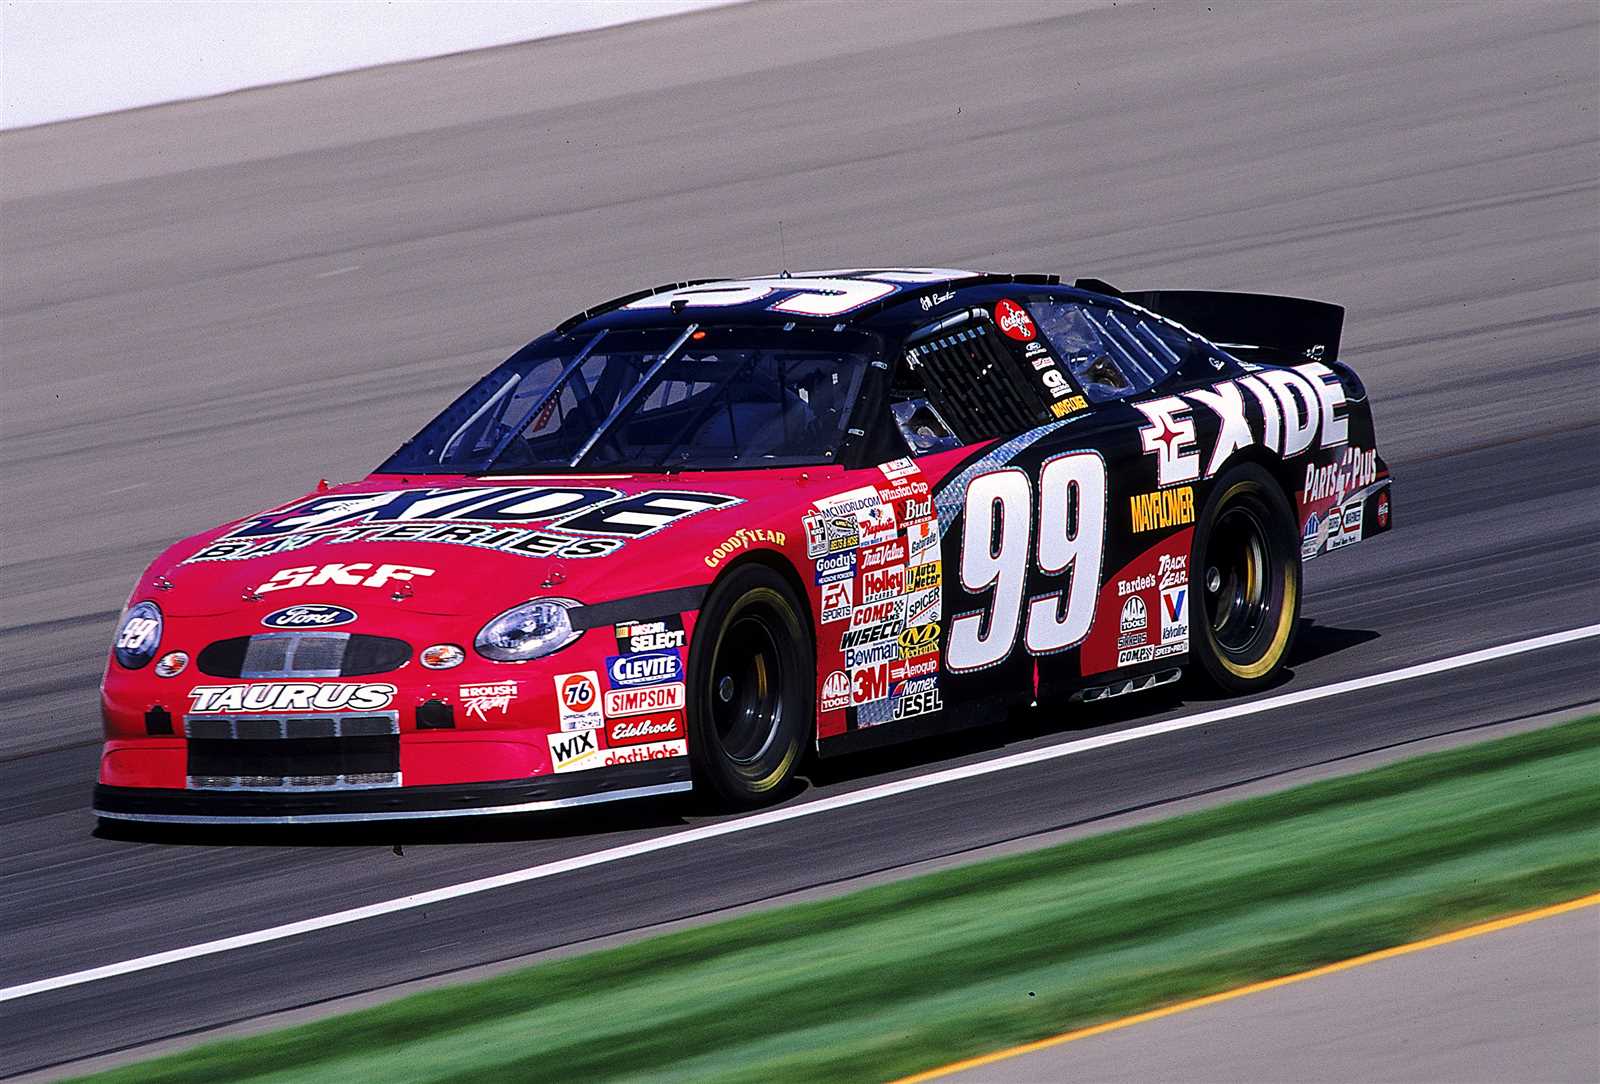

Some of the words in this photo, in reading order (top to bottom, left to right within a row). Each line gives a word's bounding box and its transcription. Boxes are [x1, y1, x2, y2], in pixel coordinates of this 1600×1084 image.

[1132, 362, 1350, 488] EXIDE
[879, 486, 913, 502] Winston
[911, 482, 929, 494] Cup
[210, 486, 747, 543] EXIDE
[905, 495, 932, 521] Bud
[1130, 486, 1195, 533] MAYFLOWER
[177, 523, 626, 567] BATTERIES
[704, 528, 786, 568] GOODYEAR
[880, 543, 905, 565] Value
[911, 532, 938, 554] Gatorade
[816, 552, 857, 573] Goody's
[916, 564, 936, 578] Auto
[946, 449, 1107, 674] 99
[1158, 554, 1187, 576] TRACK
[254, 563, 436, 594] SKF
[865, 568, 904, 596] Holley
[915, 573, 940, 590] Meter
[1118, 574, 1156, 596] Hardee's
[822, 606, 851, 621] SPORTS
[853, 602, 894, 626] COMP
[909, 587, 940, 618] SPICER
[276, 605, 339, 626] Ford
[1122, 618, 1145, 630] TOOLS
[117, 617, 158, 650] 99
[630, 630, 685, 653] SELECT
[841, 619, 902, 650] WISECO
[846, 642, 898, 668] Bowman
[1119, 647, 1146, 663] COMP
[613, 655, 677, 681] CLEVITE
[902, 658, 937, 678] Aeroquip
[471, 685, 518, 697] ROUSH
[565, 681, 592, 706] 76
[853, 663, 887, 703] 3M
[902, 677, 937, 697] Nomex
[188, 682, 398, 713] TAURUS
[612, 687, 676, 712] SIMPSON
[823, 696, 850, 708] TOOLS
[893, 688, 943, 720] JESEL
[612, 718, 677, 740] Edelbrock
[552, 731, 594, 762] WIX
